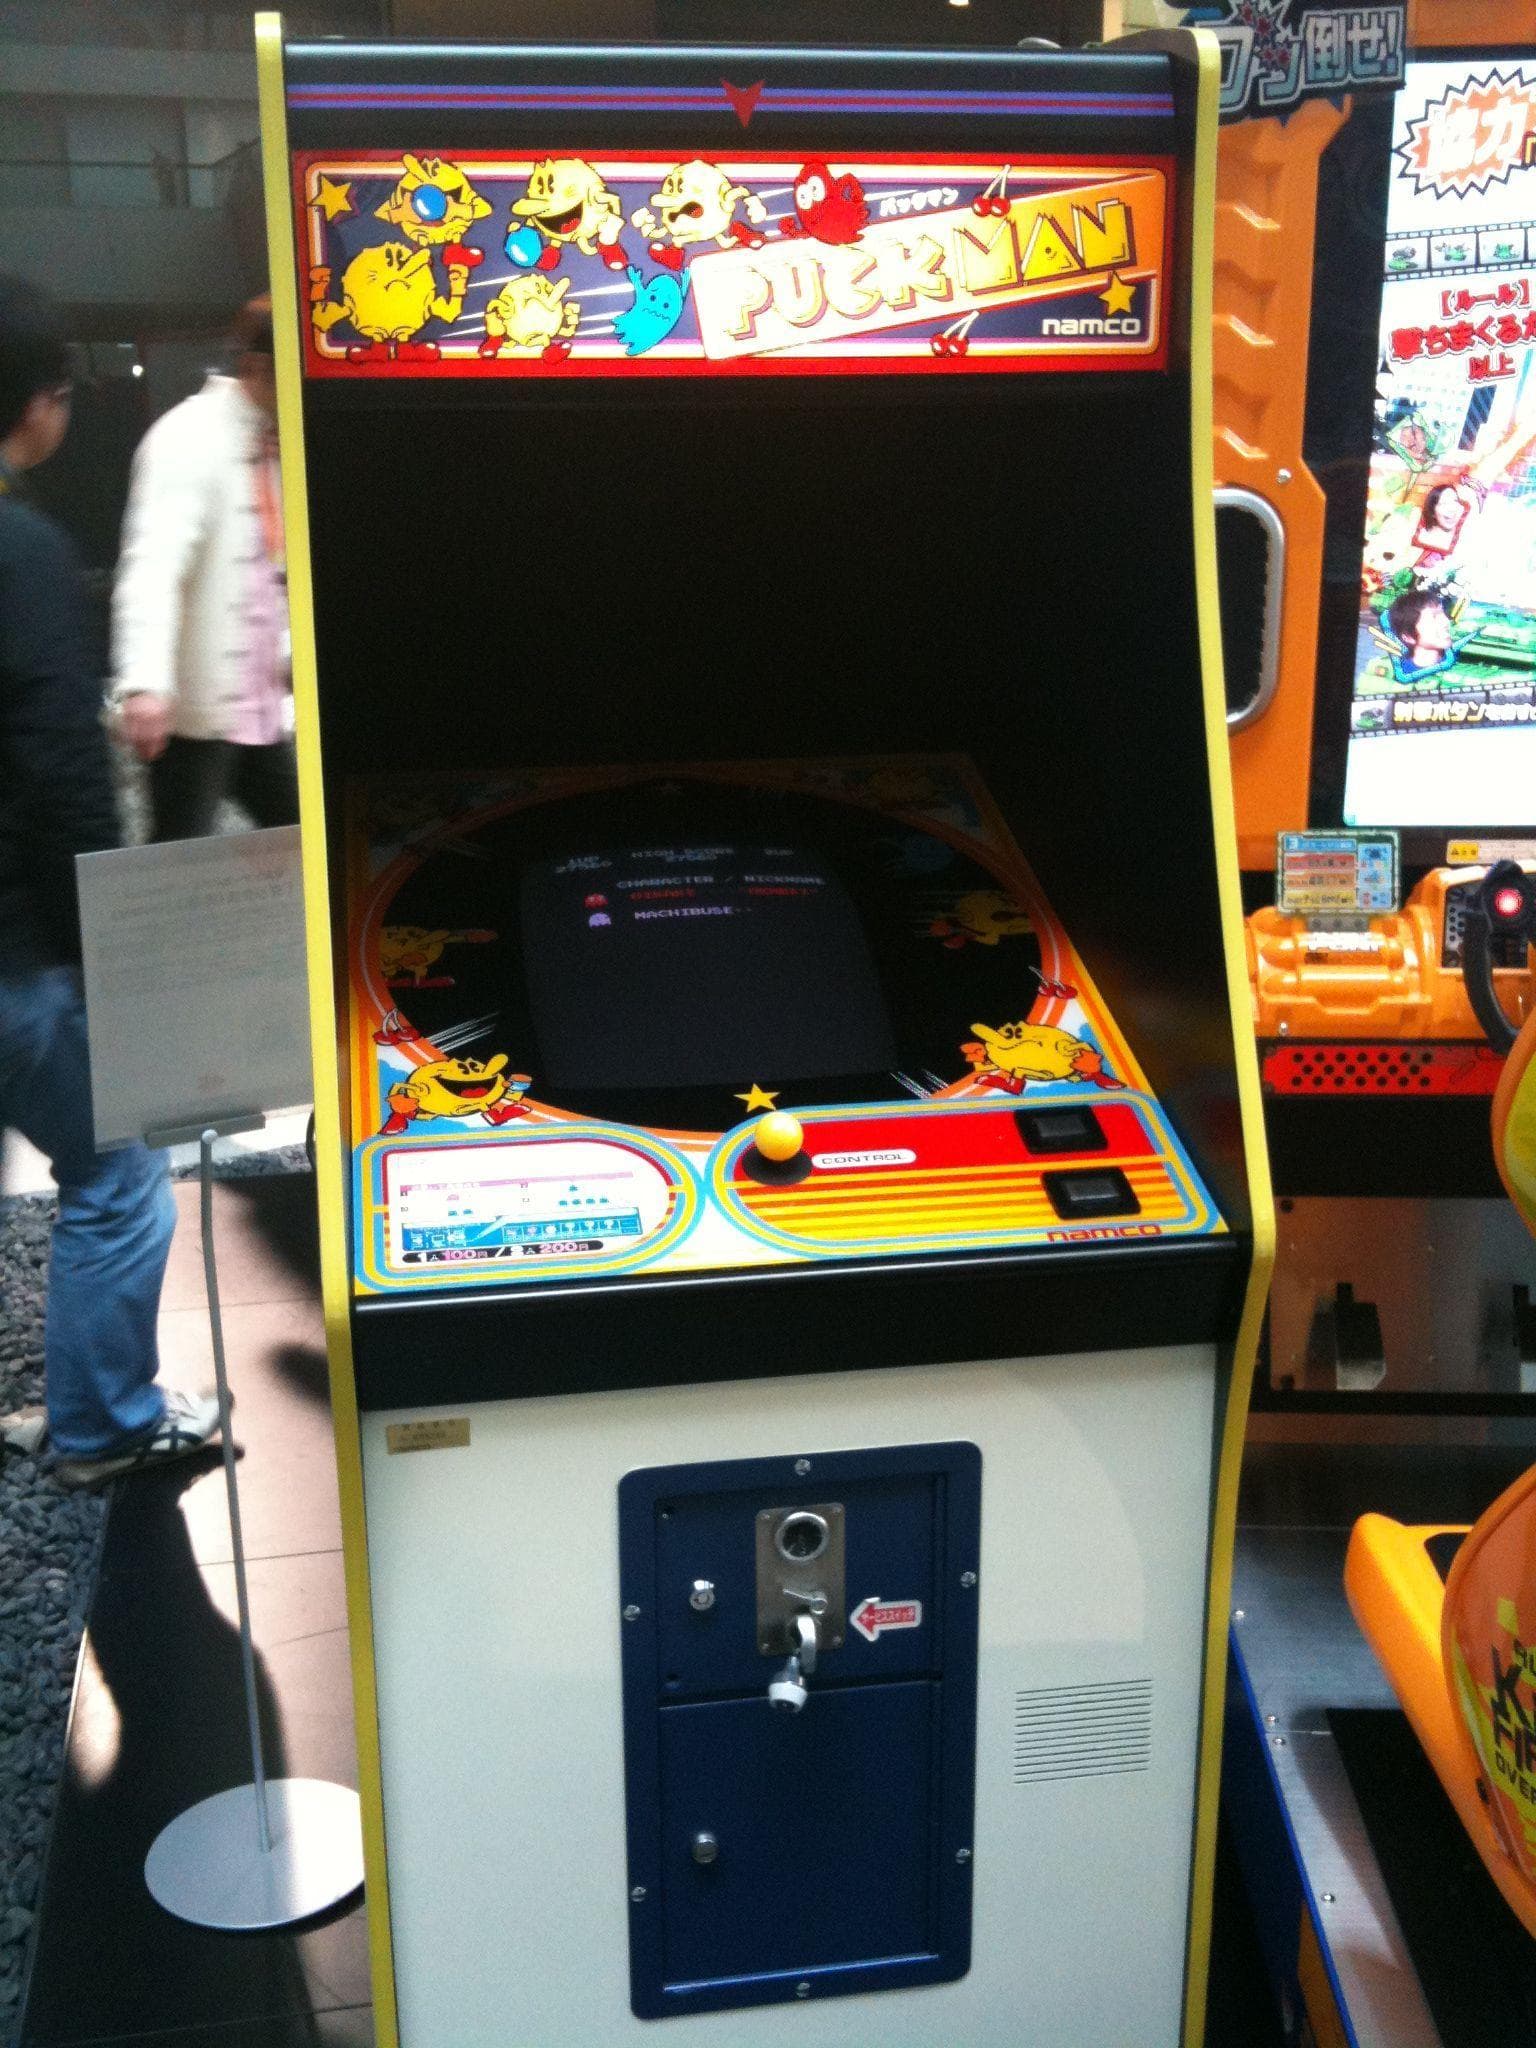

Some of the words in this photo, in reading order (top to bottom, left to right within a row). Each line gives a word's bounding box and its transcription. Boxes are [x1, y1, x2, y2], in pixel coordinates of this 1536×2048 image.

[880, 187, 959, 217] パックマン
[1042, 317, 1141, 336] namco
[616, 875, 714, 889] CHARACTER
[743, 874, 826, 886] NICKNAME
[820, 1152, 909, 1166] CONTROL
[1046, 1223, 1164, 1244] namco
